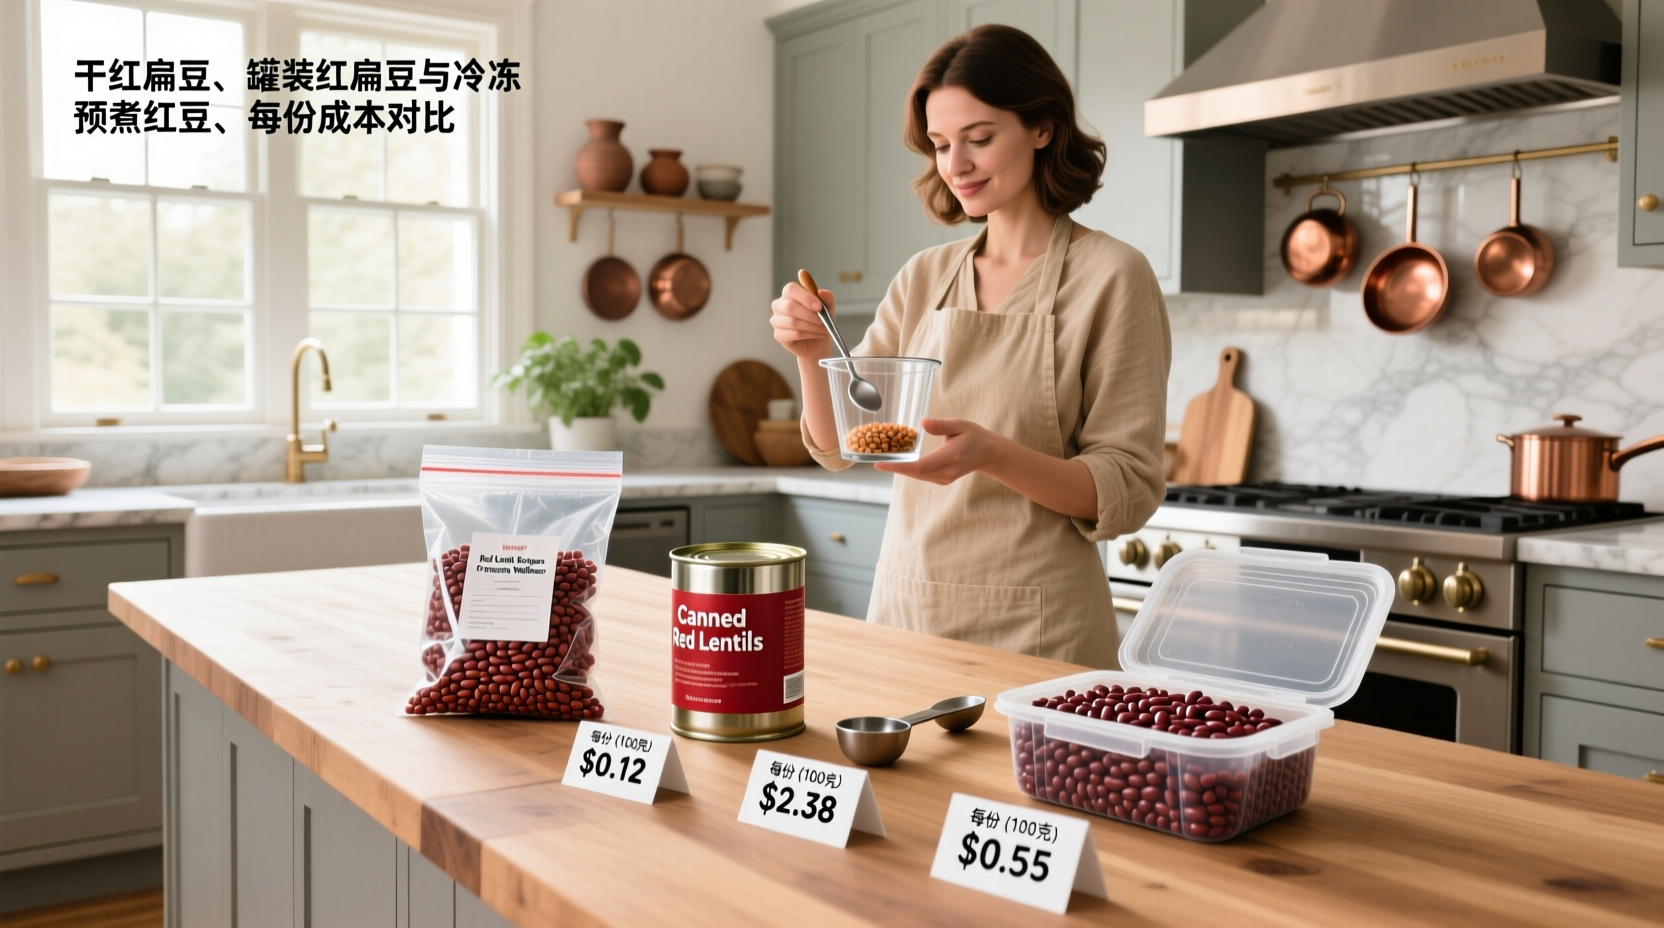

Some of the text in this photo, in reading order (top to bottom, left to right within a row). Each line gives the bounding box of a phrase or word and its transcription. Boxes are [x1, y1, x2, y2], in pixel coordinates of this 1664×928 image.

[677, 604, 747, 628] Canned
[672, 626, 764, 652] Red Lentils
[580, 748, 646, 785] $0.12
[759, 780, 837, 823] $2.38
[958, 831, 1052, 882] $0.55
